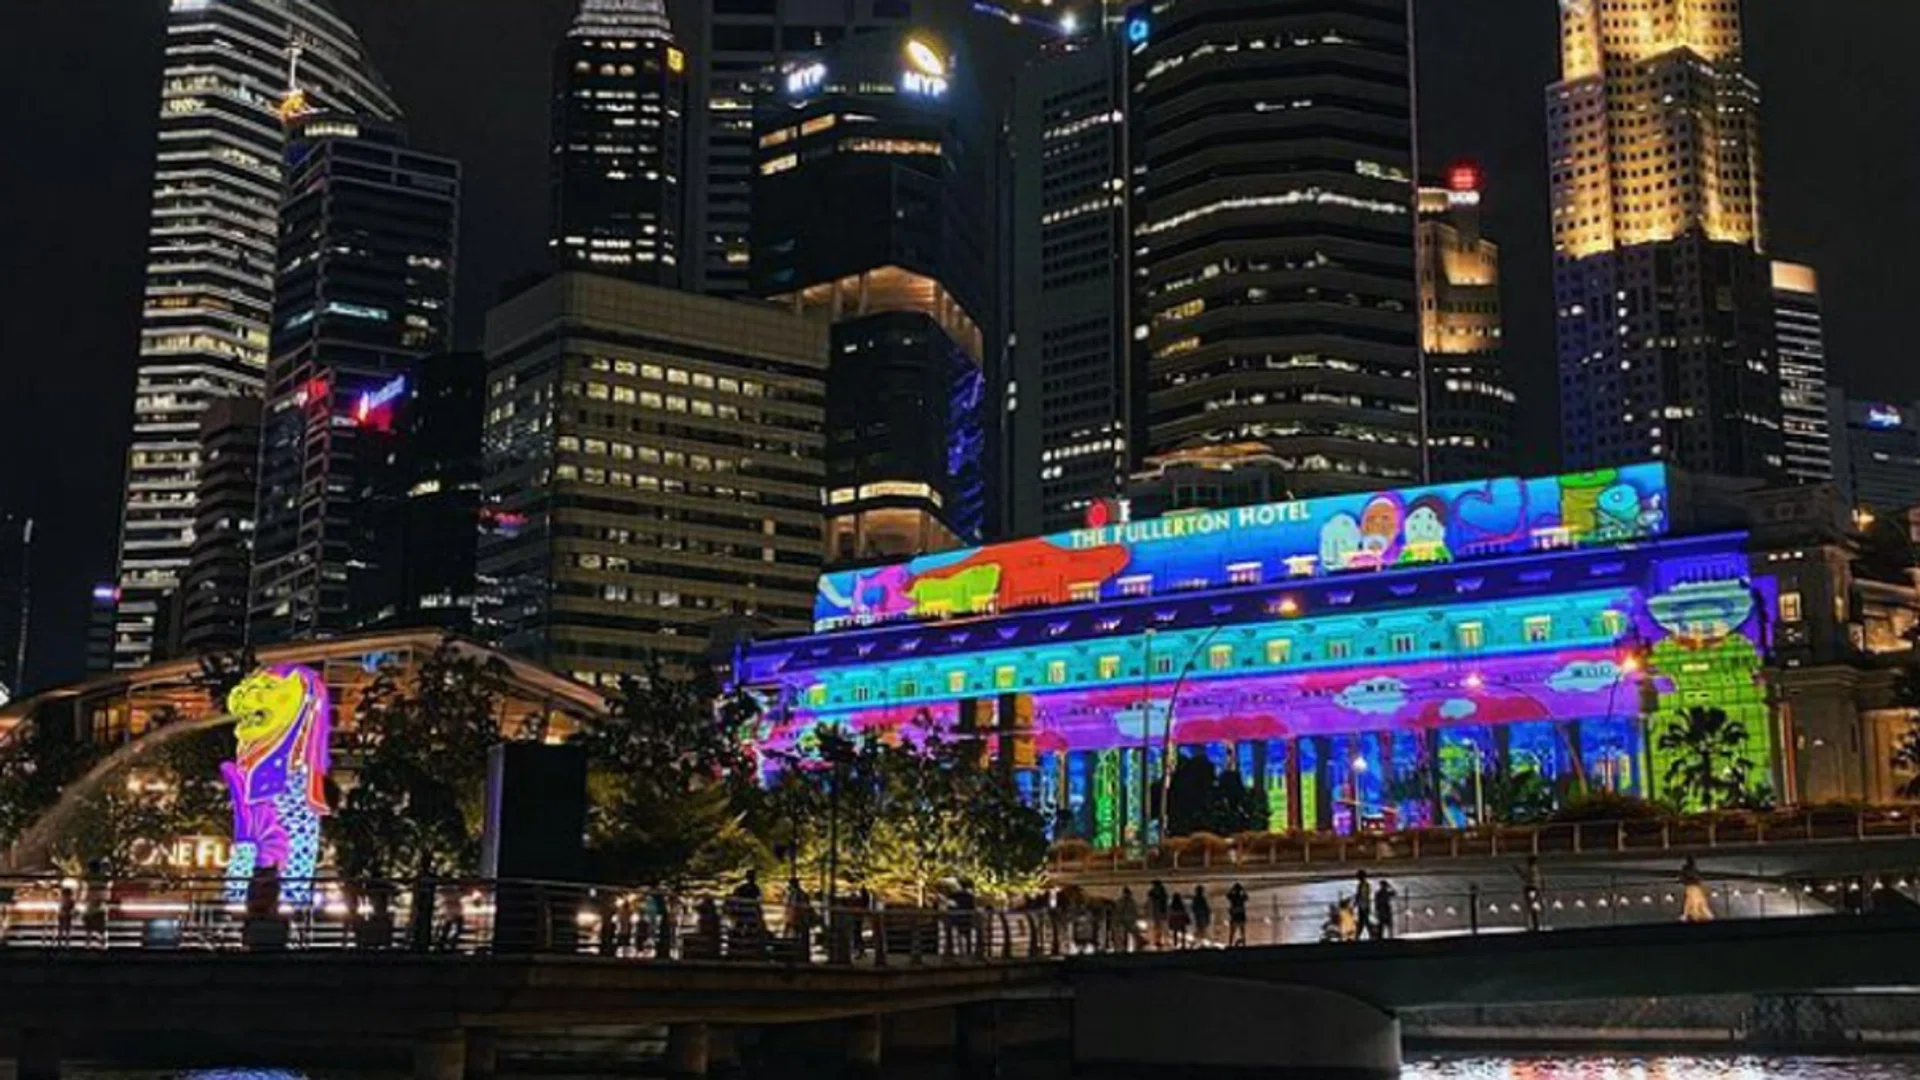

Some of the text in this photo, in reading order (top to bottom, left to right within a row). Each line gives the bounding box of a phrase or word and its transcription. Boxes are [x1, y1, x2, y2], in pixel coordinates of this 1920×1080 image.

[903, 70, 948, 97] MYP
[1070, 499, 1311, 549] THE FULLERTON HOTEL
[129, 837, 192, 867] ONE
